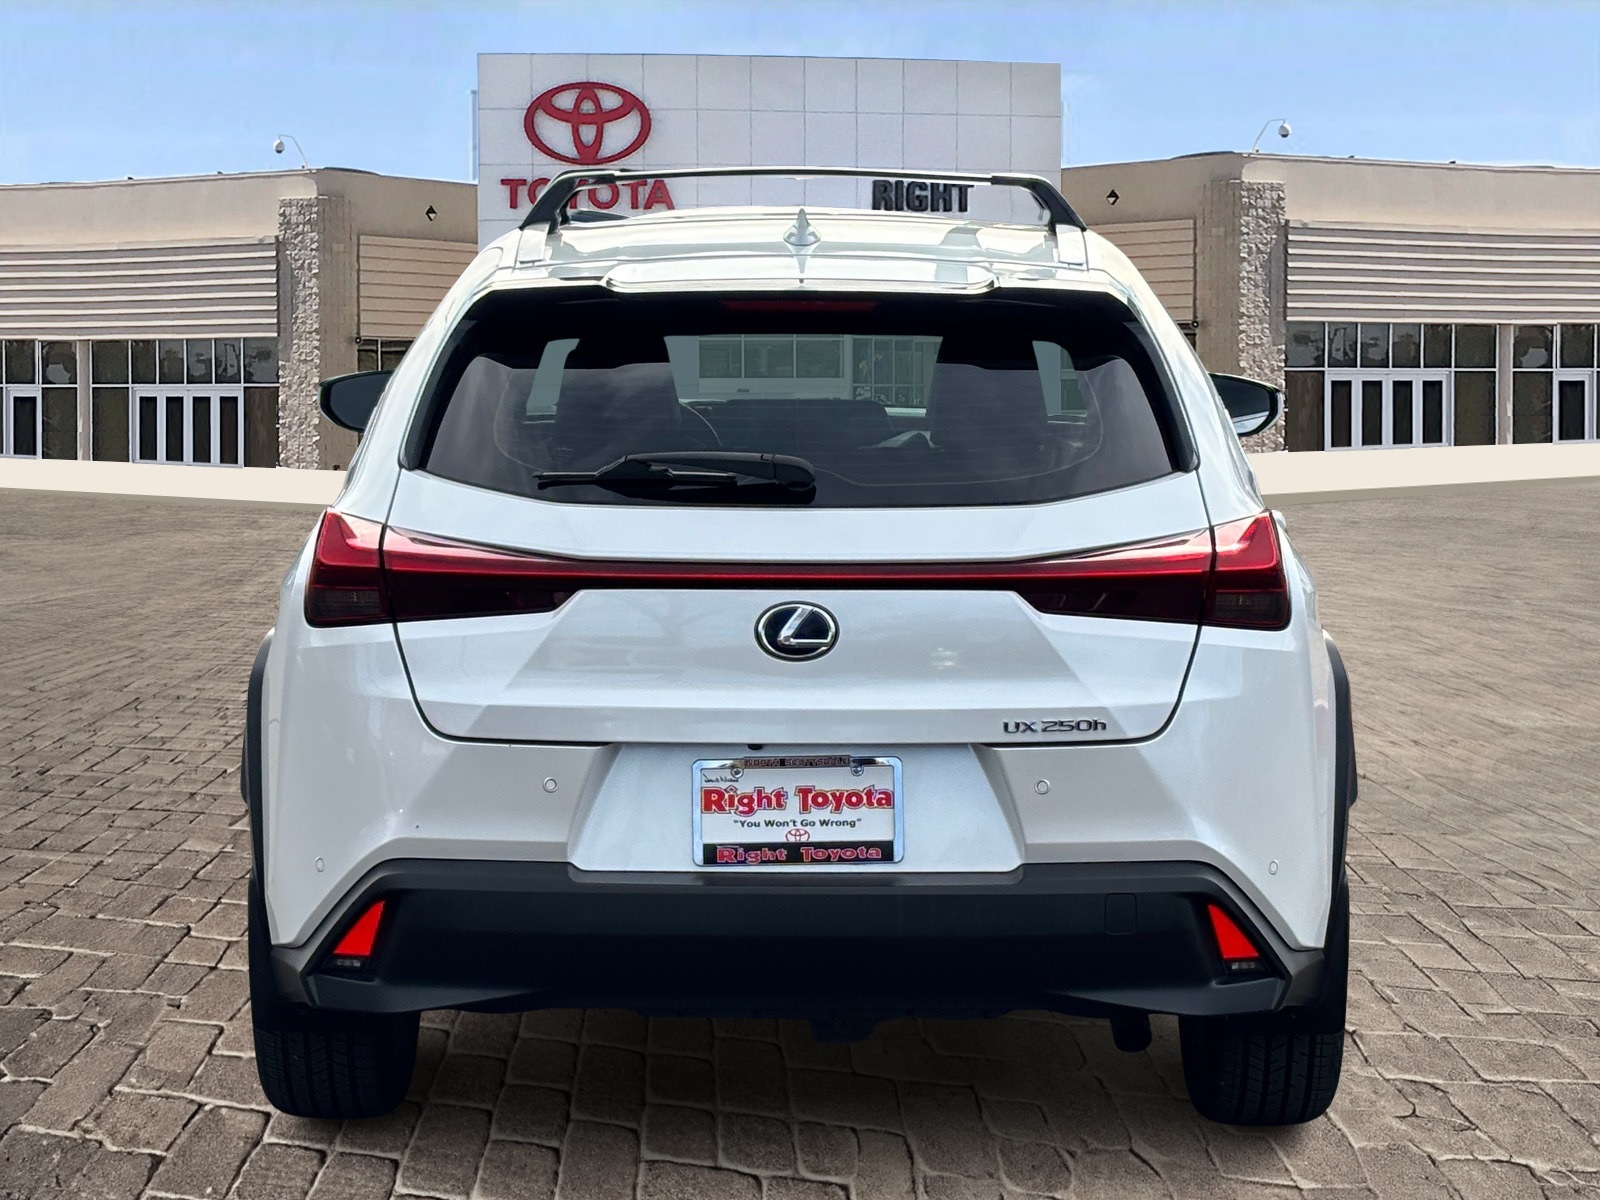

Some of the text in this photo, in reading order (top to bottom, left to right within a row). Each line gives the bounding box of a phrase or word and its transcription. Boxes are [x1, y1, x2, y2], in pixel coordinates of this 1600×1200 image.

[872, 179, 975, 213] RIGHT
[1003, 718, 1107, 734] UX 250h
[701, 785, 894, 817] Right Toyota
[764, 819, 798, 828] Won't
[800, 819, 816, 828] Go
[716, 846, 882, 864] Right Toyota
